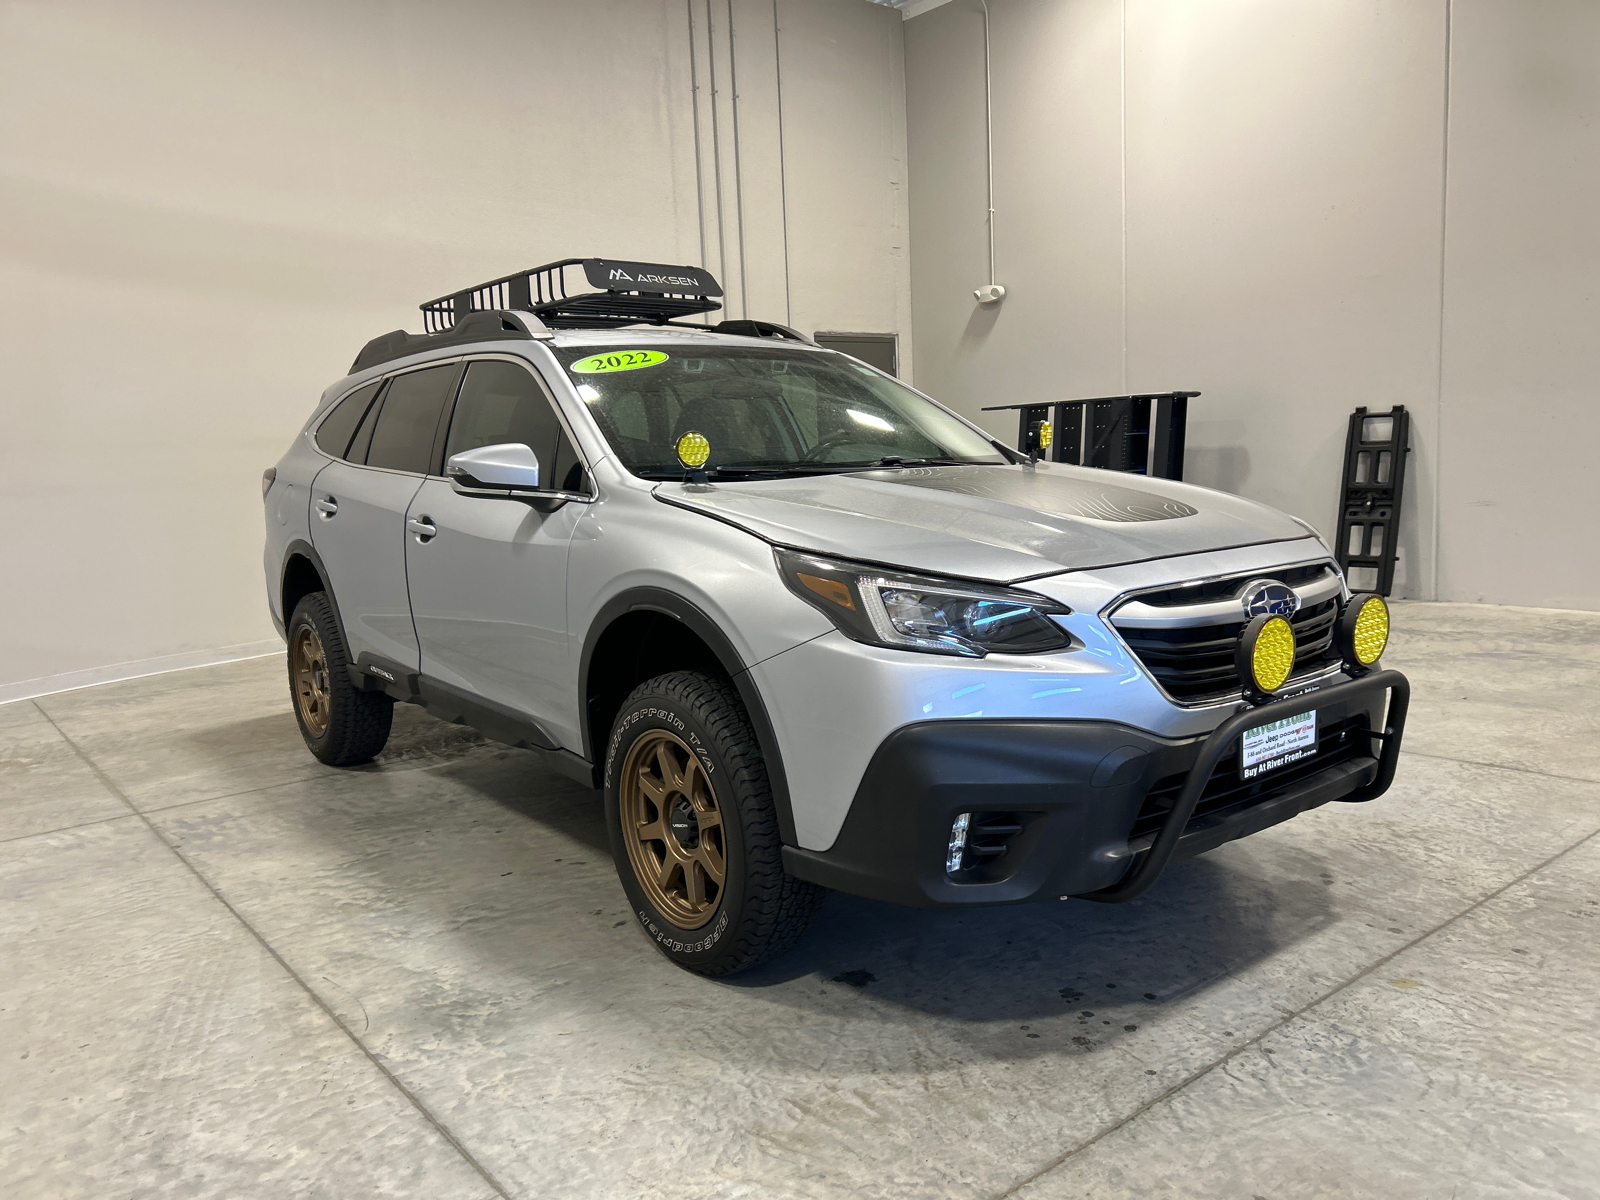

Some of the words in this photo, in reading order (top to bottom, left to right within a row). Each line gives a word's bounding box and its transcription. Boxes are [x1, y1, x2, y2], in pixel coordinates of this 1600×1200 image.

[637, 273, 700, 287] ARKSEN
[591, 352, 652, 371] 2022
[1265, 734, 1279, 744] Jeep
[1244, 766, 1258, 778] Buy
[1258, 762, 1267, 773] At
[1266, 757, 1284, 770] River
[1284, 748, 1317, 763] Front.com
[639, 910, 729, 953] BFGoodrich
